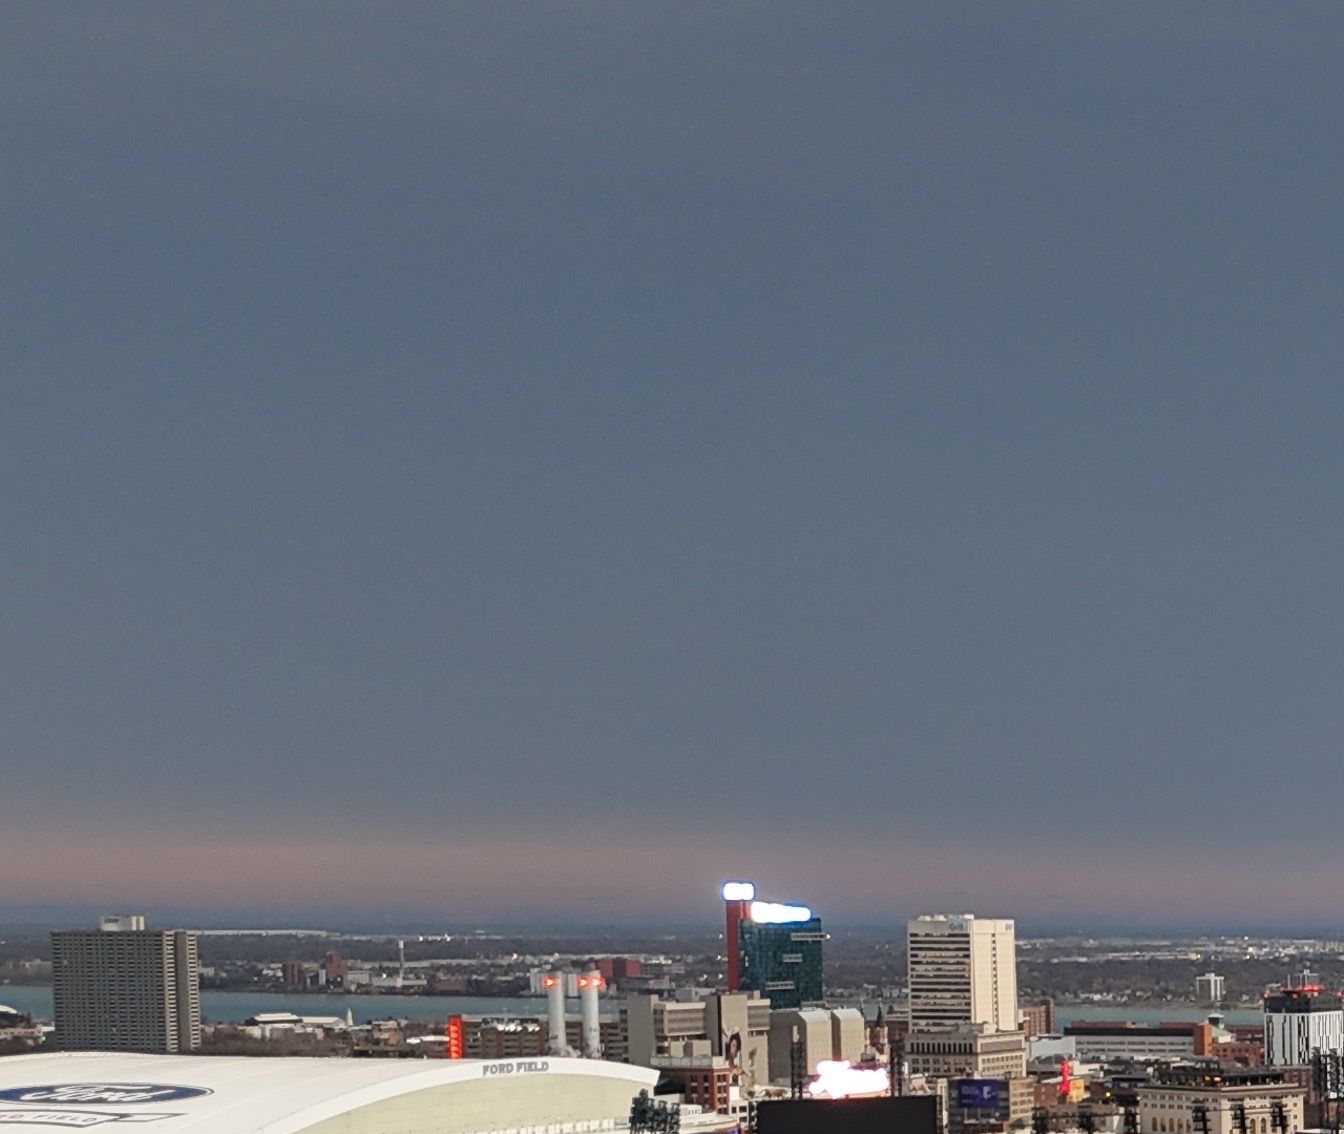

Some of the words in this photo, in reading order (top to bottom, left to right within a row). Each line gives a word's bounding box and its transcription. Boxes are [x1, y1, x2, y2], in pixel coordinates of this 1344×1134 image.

[482, 1063, 514, 1076] FORD
[516, 1061, 549, 1073] FIELD
[20, 1084, 176, 1101] Ford
